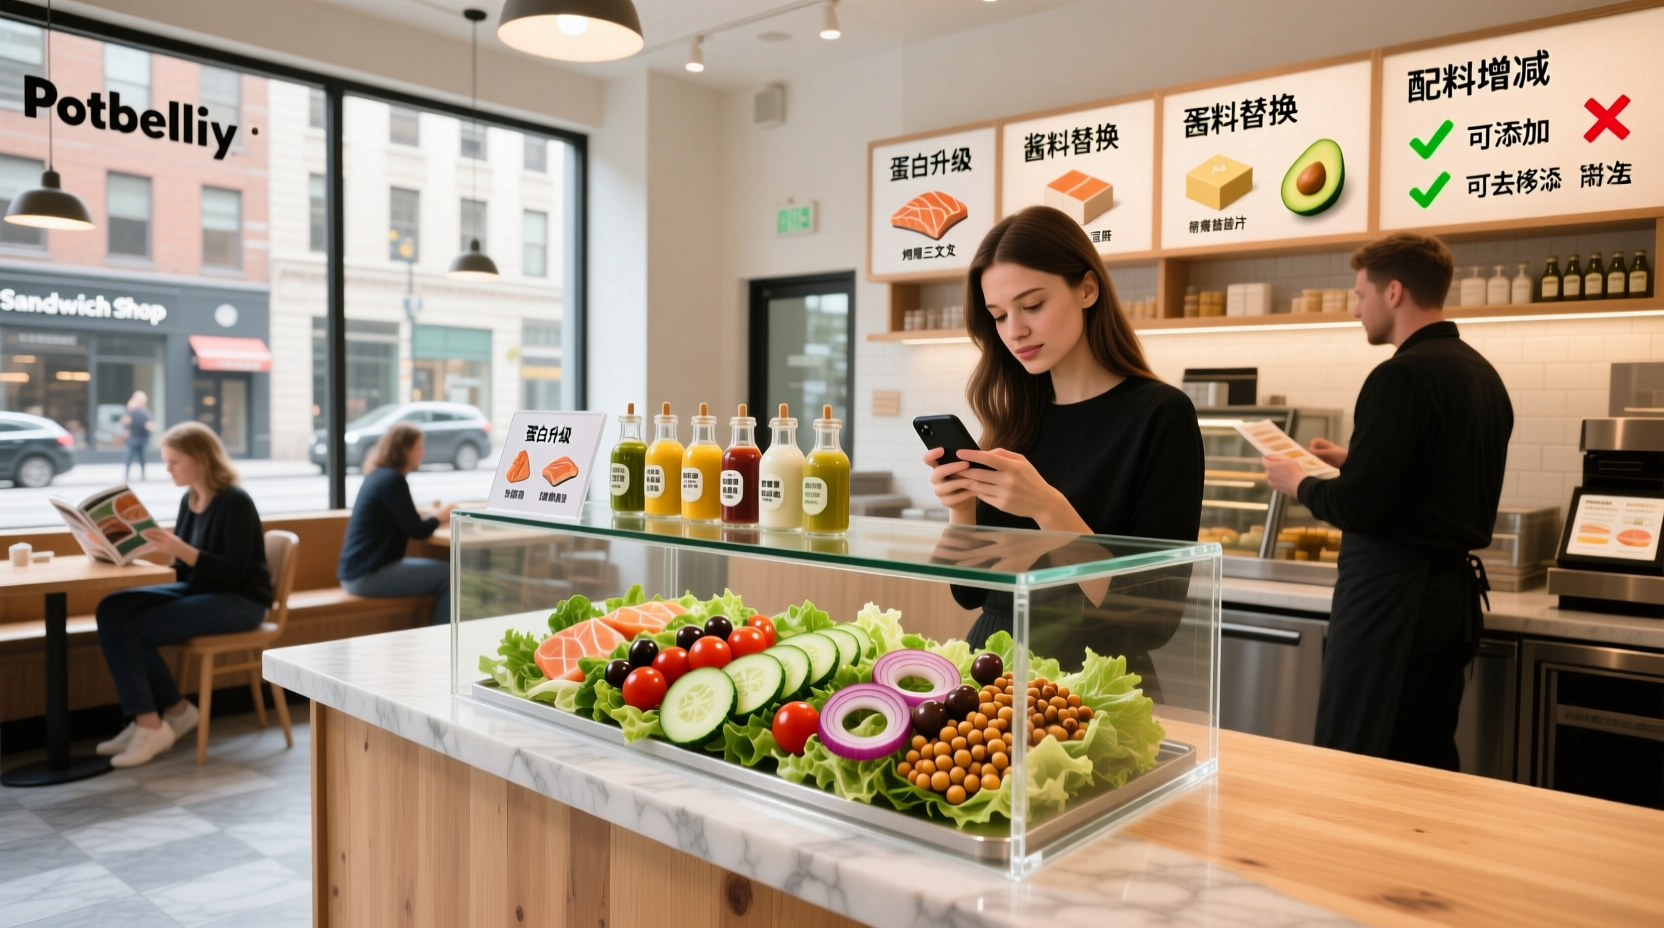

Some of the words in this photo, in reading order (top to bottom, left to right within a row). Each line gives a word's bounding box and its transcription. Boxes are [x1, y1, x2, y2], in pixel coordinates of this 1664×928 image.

[1407, 49, 1550, 103] 配料增减
[24, 75, 237, 160] Potbelliy
[1467, 118, 1550, 150] 可添加
[1024, 123, 1119, 162] 酱料替换
[890, 147, 972, 182] 蛋白升级
[0, 288, 111, 318] Sandwich
[112, 297, 167, 326] Shop
[525, 425, 572, 444] 蛋白升级
